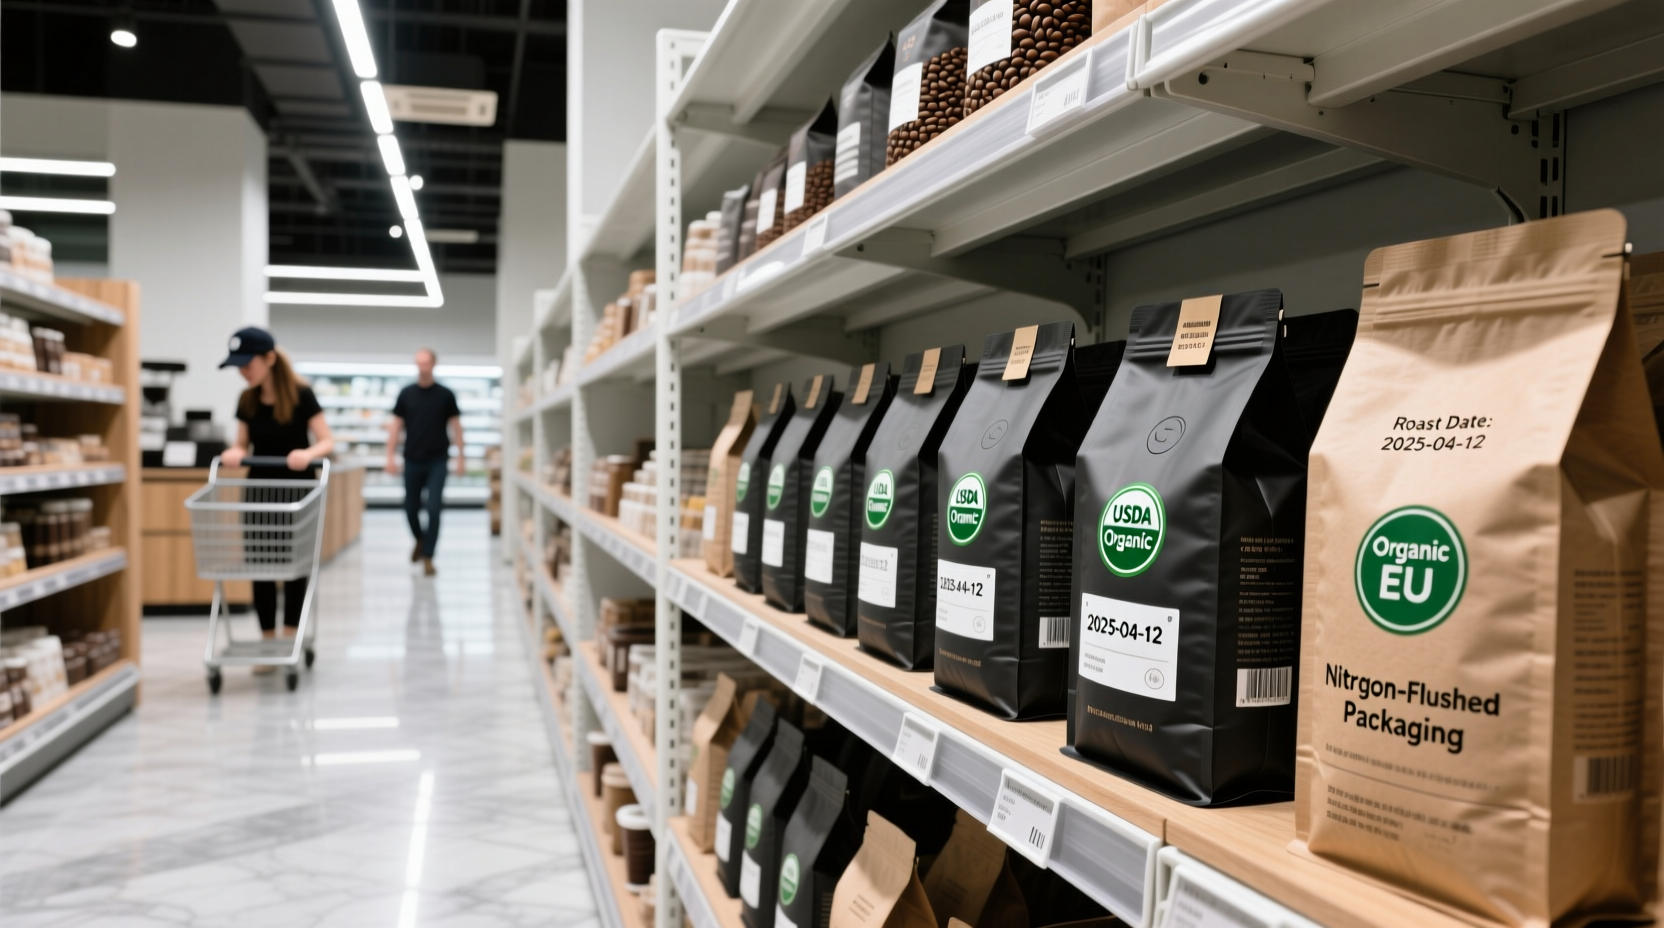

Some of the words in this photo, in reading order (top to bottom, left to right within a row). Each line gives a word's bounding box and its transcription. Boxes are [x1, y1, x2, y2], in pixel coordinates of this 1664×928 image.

[1393, 416, 1442, 431] Roast
[1445, 415, 1493, 430] Date:
[1380, 434, 1486, 451] 2025-04-12
[1112, 504, 1152, 526] USDA
[1103, 528, 1153, 552] Organic
[1372, 535, 1451, 565] Organic
[1379, 563, 1434, 604] EU
[1087, 613, 1163, 645] 2025-04-12
[1325, 662, 1500, 716] Nitrgon-Flushed
[1343, 700, 1464, 755] Packaging
